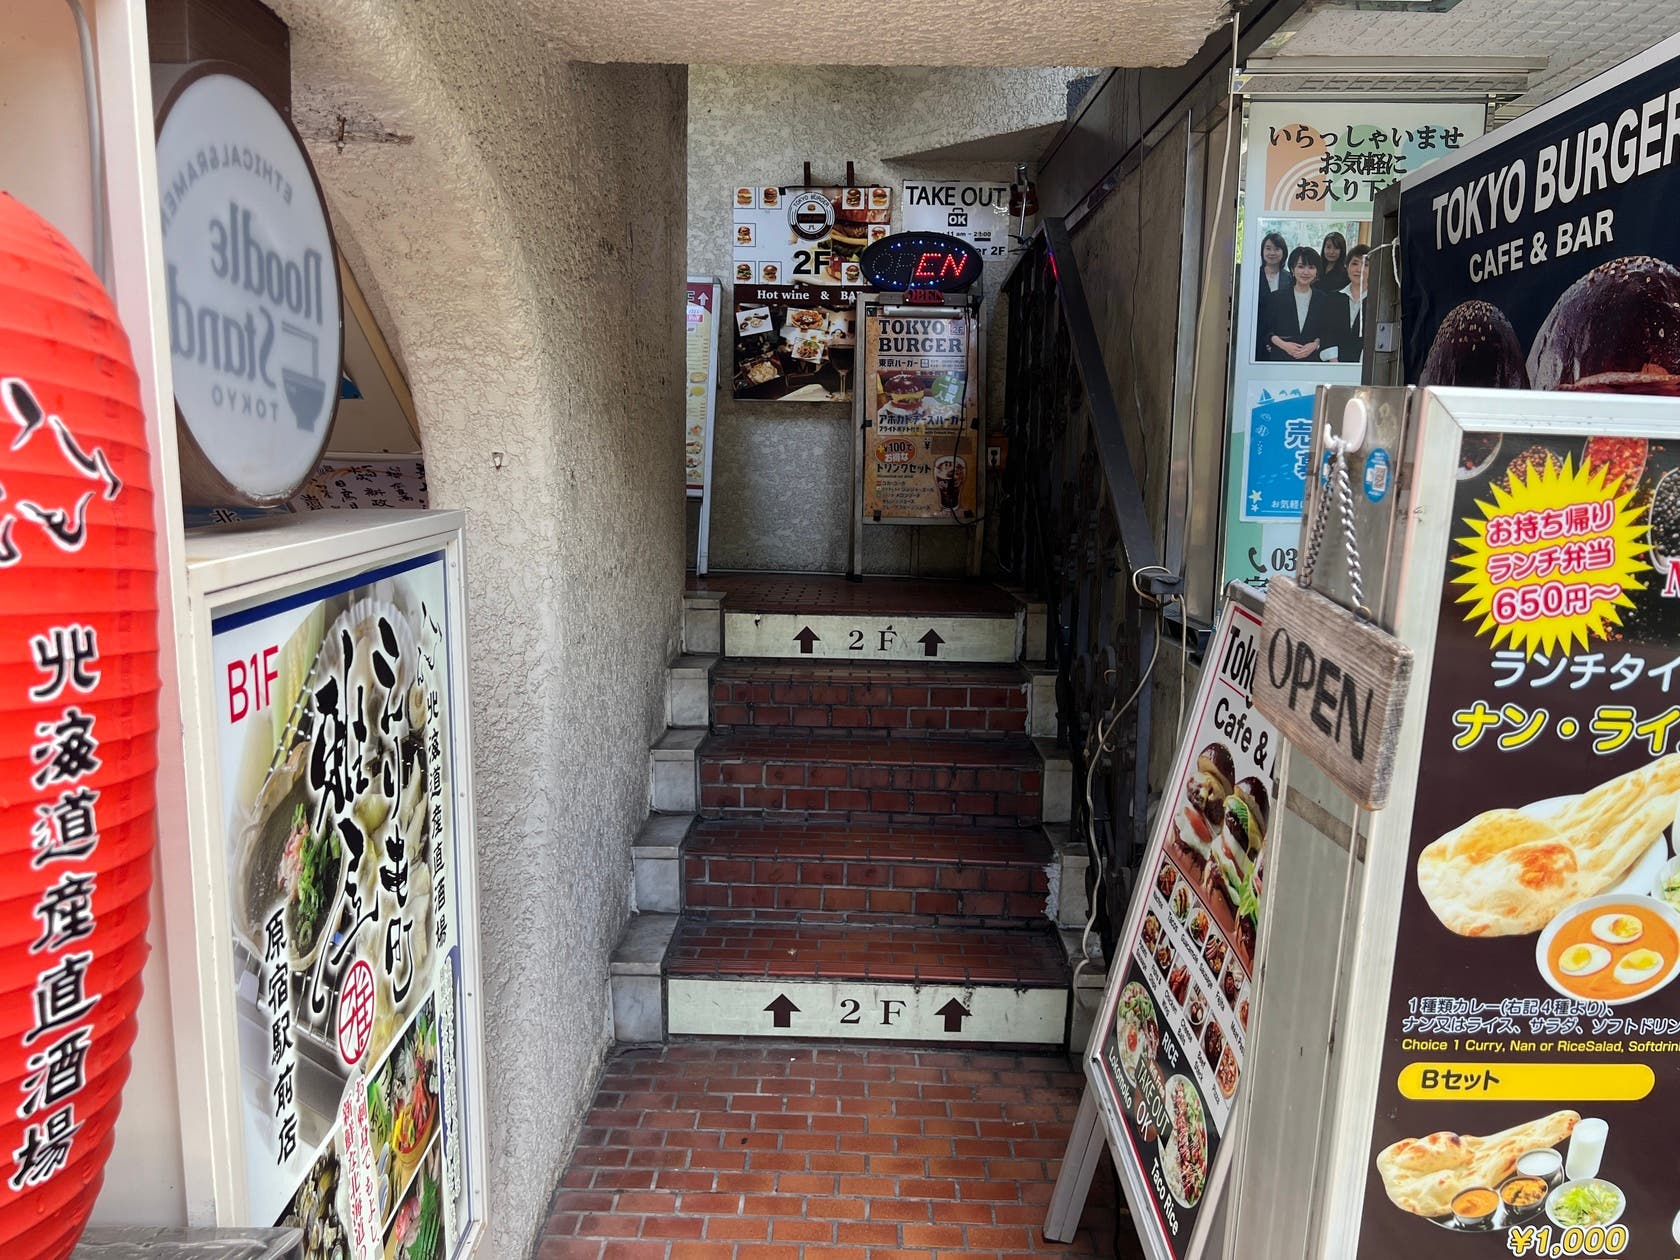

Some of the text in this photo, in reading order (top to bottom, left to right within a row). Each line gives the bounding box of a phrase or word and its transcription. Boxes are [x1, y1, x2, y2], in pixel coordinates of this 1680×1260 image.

[1269, 124, 1464, 149] いらっしゃいませ
[1319, 151, 1407, 175] お気軽に
[1432, 87, 1680, 250] TOKYO BURGER
[905, 186, 1006, 206] TAKE OUT
[949, 216, 966, 224] OK
[793, 250, 831, 275] 2F
[991, 246, 1006, 255] 2F
[1469, 209, 1614, 283] CAFE & BAR
[757, 289, 778, 301] Hot
[782, 289, 809, 301] wine
[821, 290, 830, 301] &
[879, 320, 945, 335] TOKYO
[879, 338, 962, 352] BURGER
[1488, 502, 1614, 544] お持ち帰り
[1487, 540, 1614, 583] ランチ弁当
[227, 645, 278, 724] B1F
[1268, 627, 1374, 764] OPEN
[1214, 698, 1269, 771] Cafe &
[1453, 701, 1680, 755] ナン・ライ
[10, 626, 99, 1189] 北海道産直酒場
[264, 907, 299, 1167] 原宿駅前店
[1161, 1031, 1179, 1069] RICE
[1402, 1038, 1448, 1051] Choice
[1454, 1039, 1460, 1051] 1
[1465, 1039, 1506, 1053] Curry,
[1509, 1039, 1536, 1051] Nan
[1540, 1041, 1555, 1052] or
[1137, 1060, 1170, 1136] TAKE OUT
[1420, 1069, 1501, 1091] Bセット
[1136, 1100, 1153, 1142] OK
[1150, 1158, 1179, 1237] Taco Rice
[1508, 1224, 1629, 1259] ¥1,000
